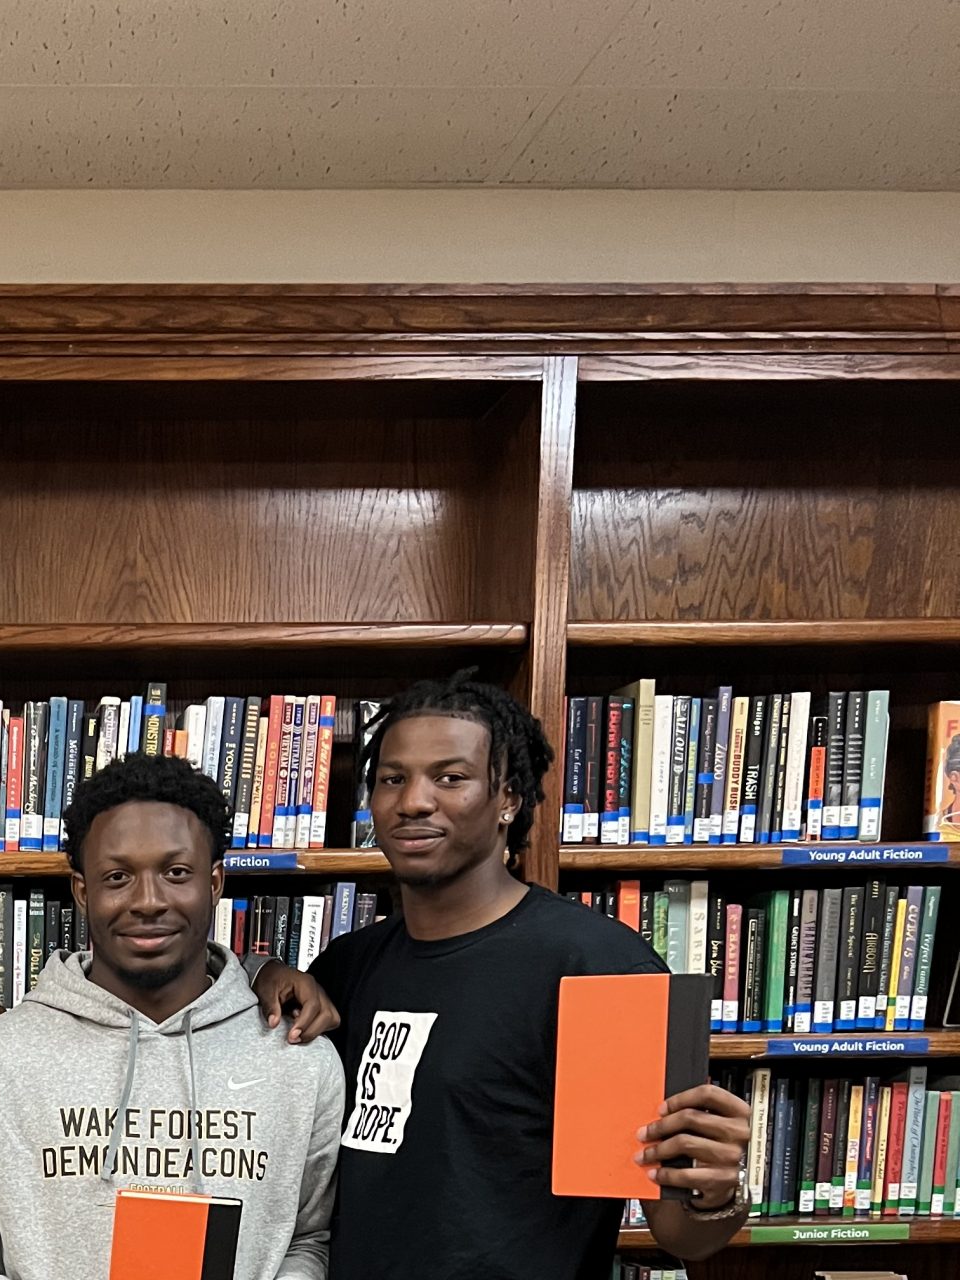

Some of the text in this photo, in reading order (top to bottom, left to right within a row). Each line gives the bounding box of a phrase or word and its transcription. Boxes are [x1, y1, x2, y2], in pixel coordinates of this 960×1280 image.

[67, 739, 78, 780] Mourning
[223, 750, 234, 788] YOUNG
[279, 734, 291, 768] VIETNAM
[290, 736, 301, 769] VIETNAM
[252, 764, 263, 806] FREEWILL
[264, 741, 278, 820] GOLD DUST
[571, 749, 583, 795] far far away
[729, 754, 741, 811] BUDDY BUSH
[745, 765, 760, 800] TRASH
[229, 855, 270, 868] Fiction
[808, 847, 923, 864] Young Adult Fiction
[307, 910, 318, 958] THE FEMALE
[906, 904, 919, 942] CUBA
[30, 948, 43, 972] DOLL
[728, 933, 739, 980] HABIBI
[789, 926, 800, 977] QUIET STORM
[862, 932, 879, 974] AIRBORN
[920, 933, 933, 964] Perfect
[369, 1021, 411, 1061] GOD
[792, 1040, 905, 1054] Young Adult Fiction
[361, 1062, 381, 1101] IS
[59, 1107, 257, 1142] WAKE FOREST
[41, 1145, 269, 1181] DEMON DEACONS
[791, 1227, 870, 1240] Junior Fiction
